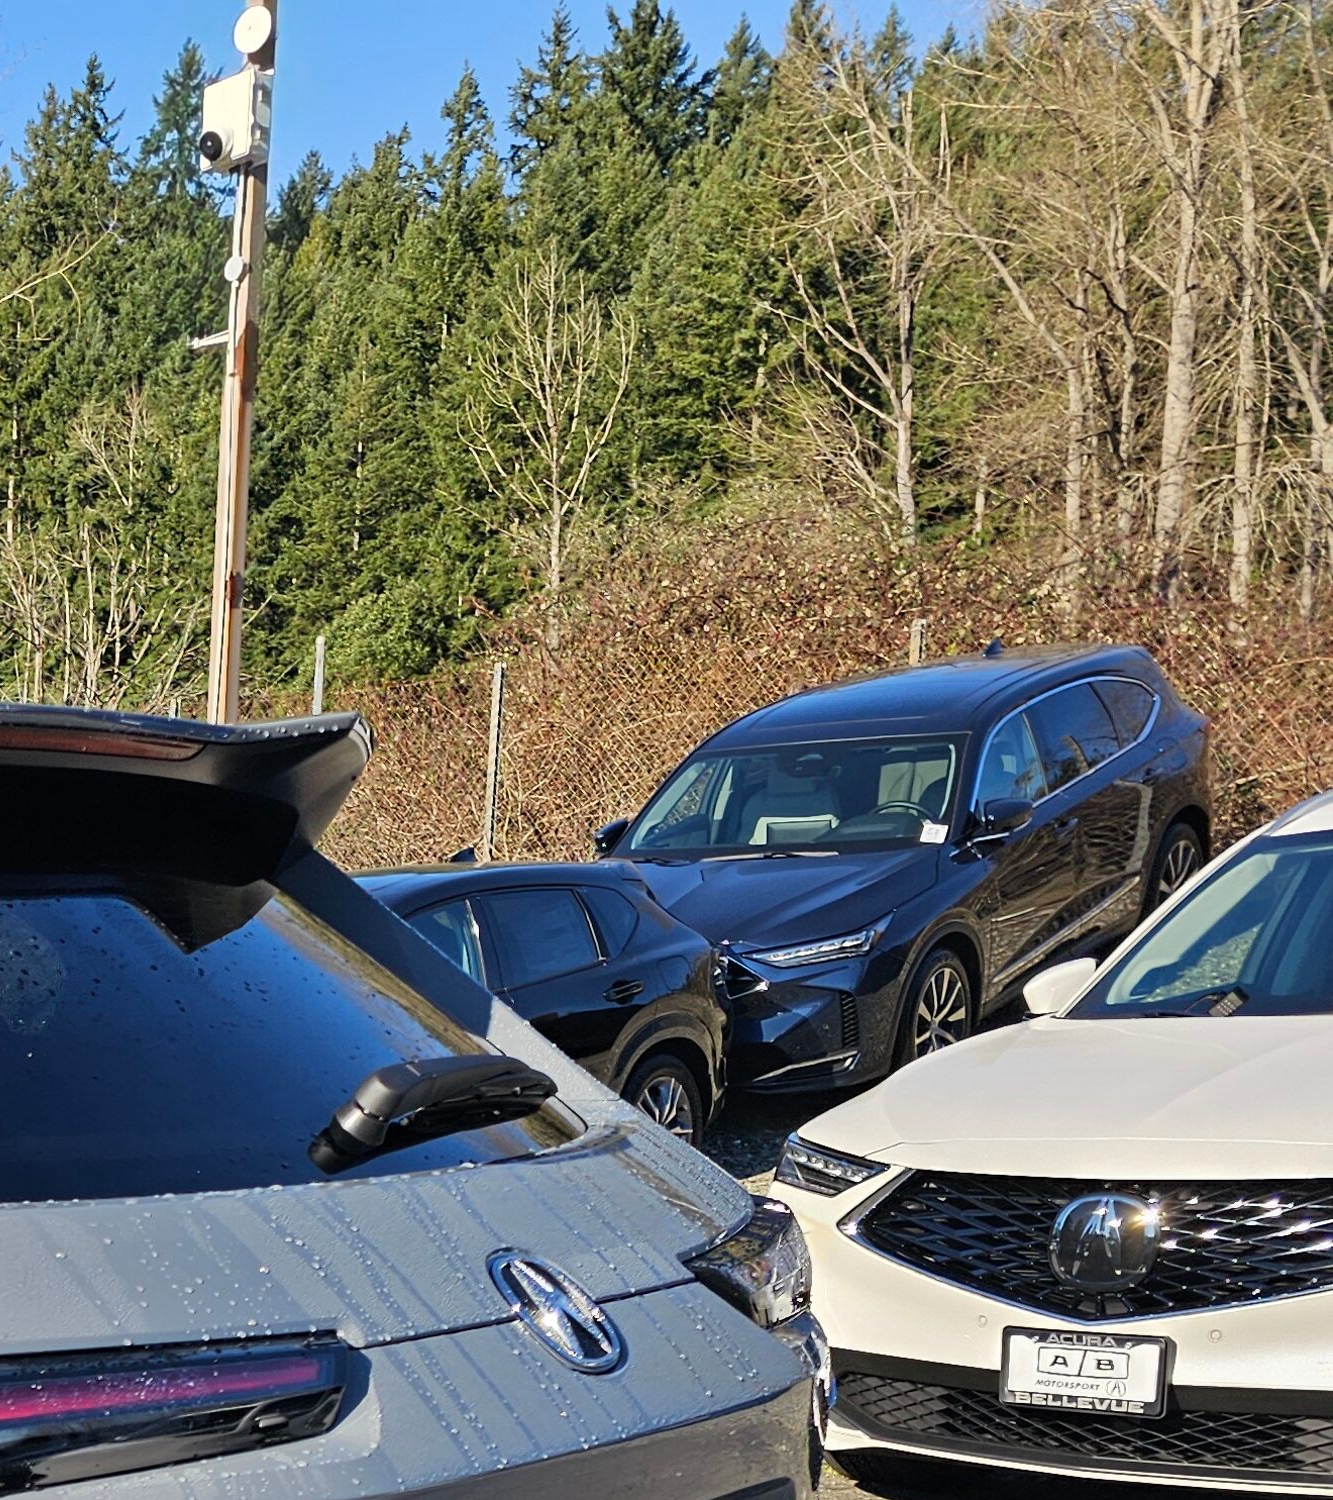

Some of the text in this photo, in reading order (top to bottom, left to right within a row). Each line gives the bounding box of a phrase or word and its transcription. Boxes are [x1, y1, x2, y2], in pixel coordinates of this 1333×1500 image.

[1046, 1333, 1117, 1348] ACURA
[1049, 1355, 1115, 1371] A B
[1035, 1379, 1100, 1391] MOTORSPORT
[1014, 1391, 1145, 1414] BELLEVUE
